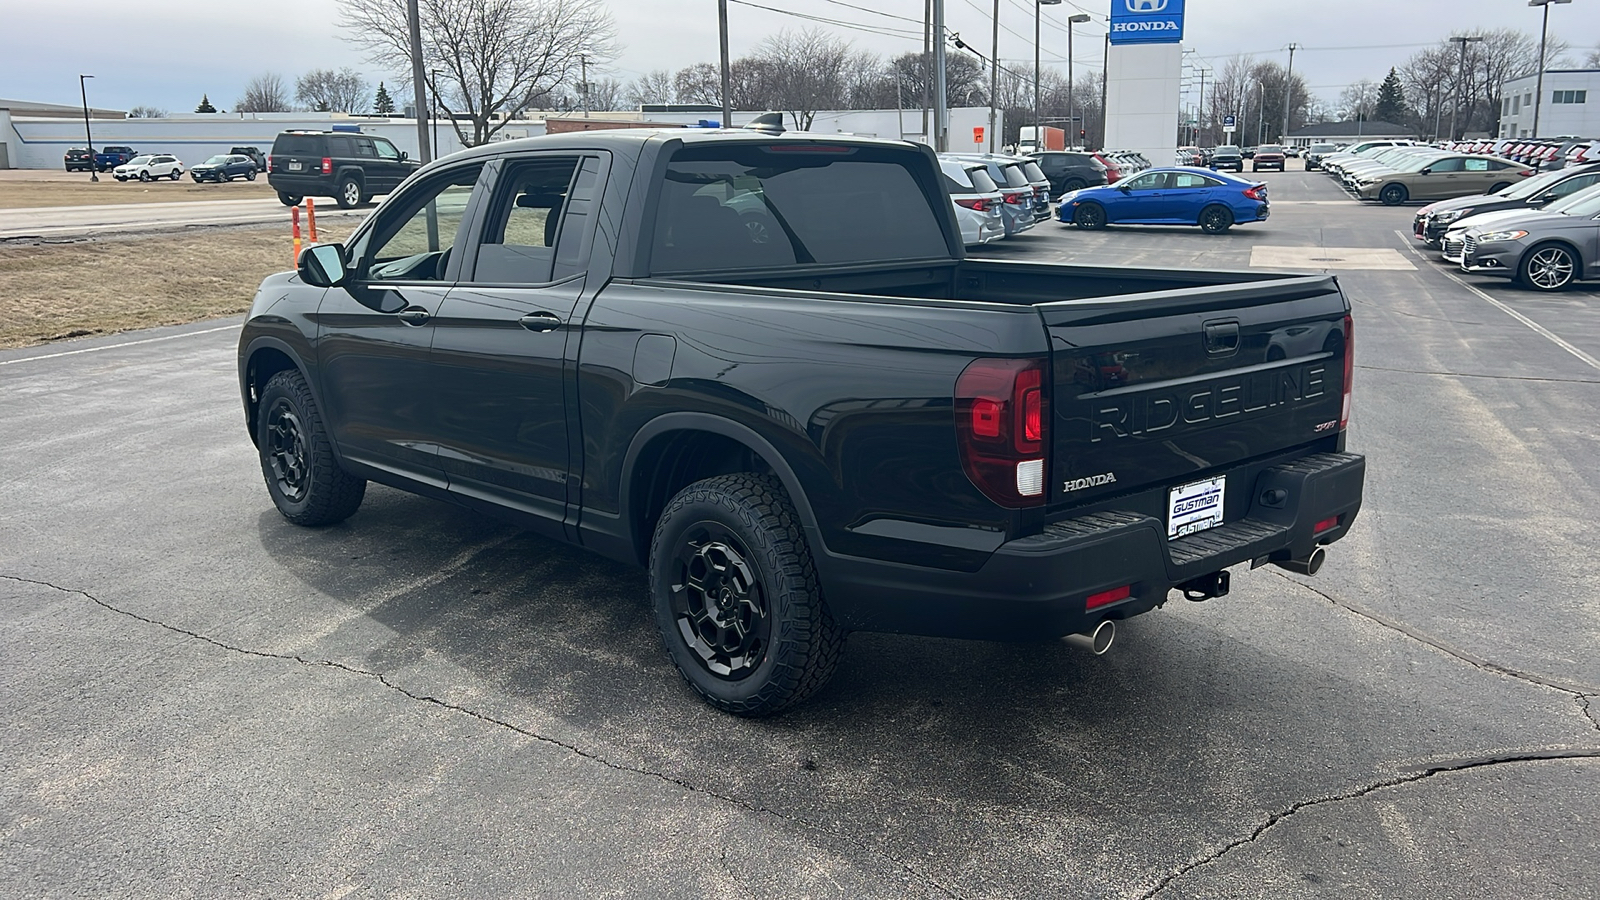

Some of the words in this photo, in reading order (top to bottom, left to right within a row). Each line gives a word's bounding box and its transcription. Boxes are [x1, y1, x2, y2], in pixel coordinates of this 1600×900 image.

[1113, 21, 1179, 32] HONDA
[1091, 364, 1326, 443] RIDGELINE
[1063, 472, 1117, 492] HONDA
